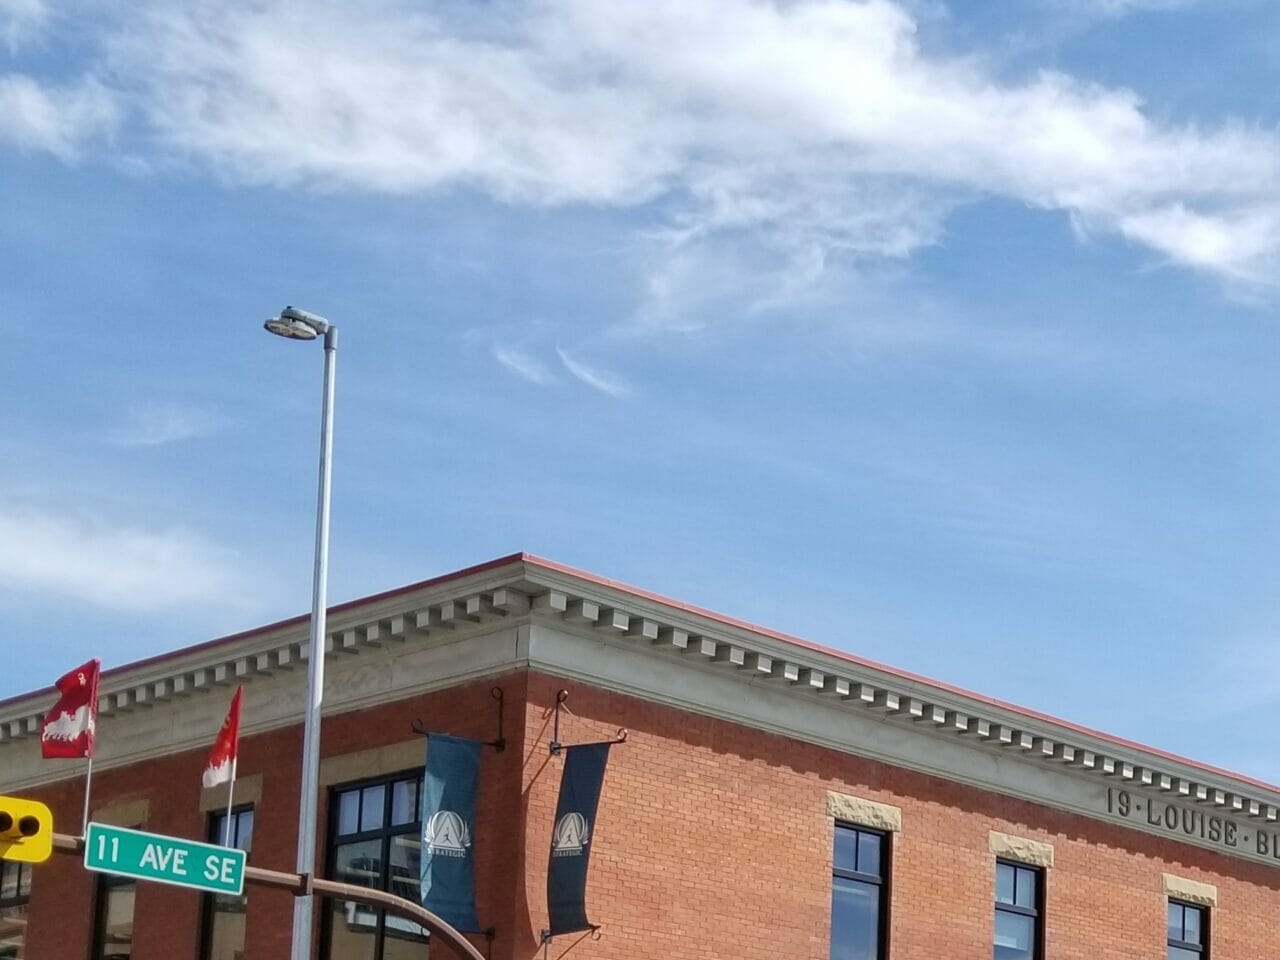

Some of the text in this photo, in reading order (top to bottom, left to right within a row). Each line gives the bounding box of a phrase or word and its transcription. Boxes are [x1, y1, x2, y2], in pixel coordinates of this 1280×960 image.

[98, 834, 236, 884] 11 AVE SE
